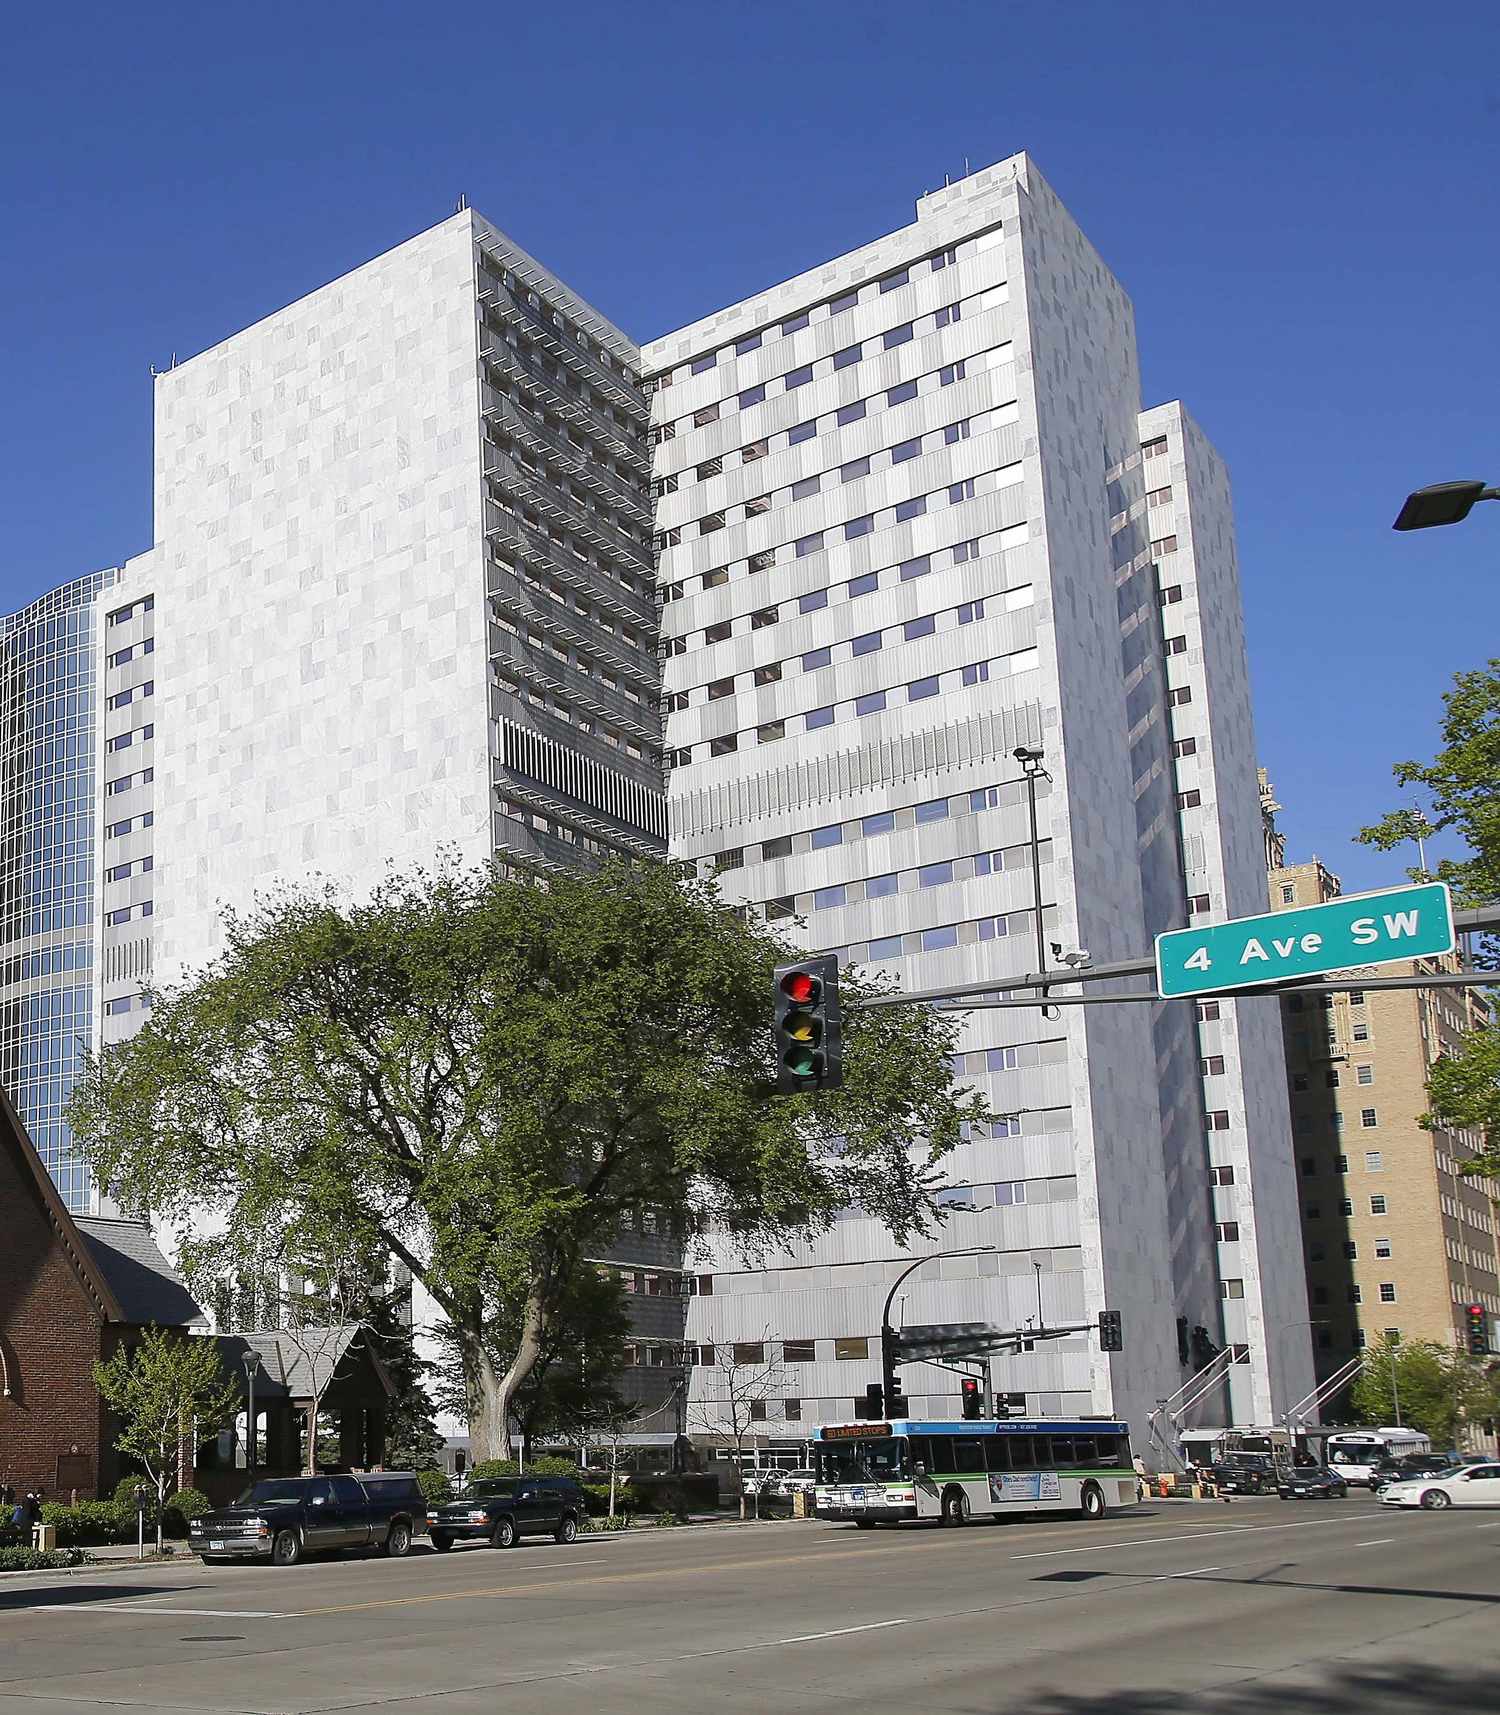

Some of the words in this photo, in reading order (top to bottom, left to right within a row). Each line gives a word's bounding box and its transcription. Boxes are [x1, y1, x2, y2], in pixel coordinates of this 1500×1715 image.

[1183, 947, 1212, 972] 4
[1239, 933, 1323, 965] Ave
[1349, 909, 1419, 945] SW
[837, 1427, 861, 1437] LIMITED
[862, 1426, 887, 1436] STOPS
